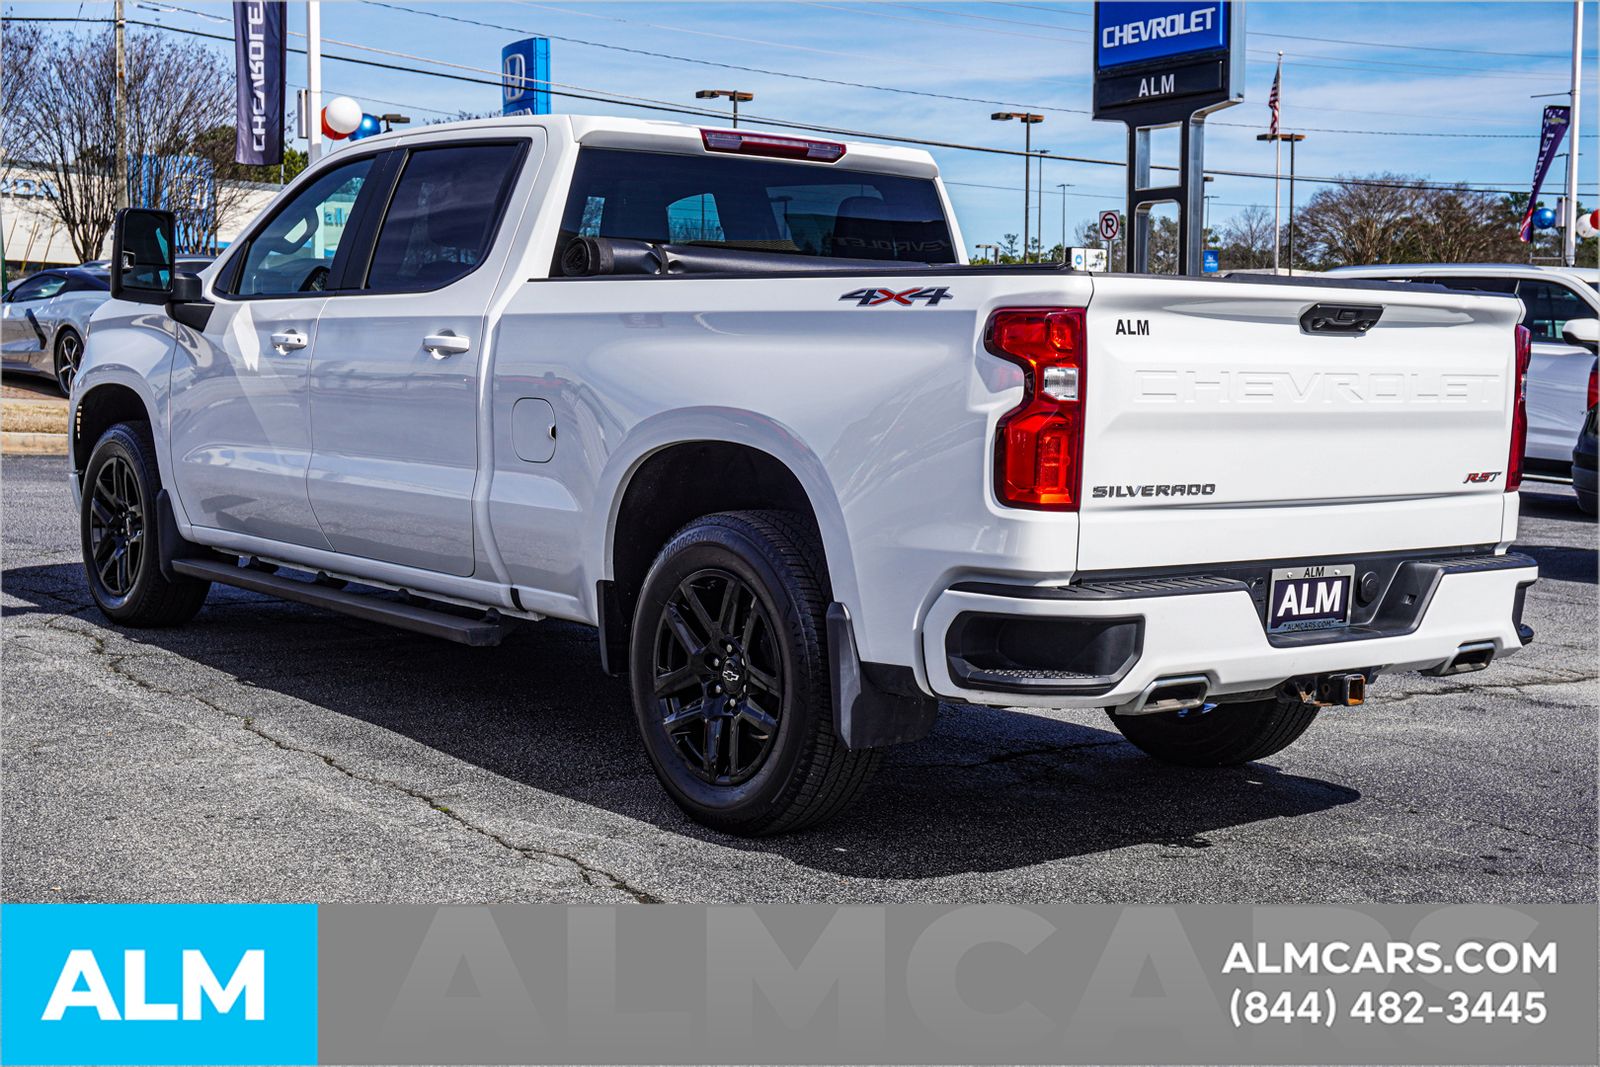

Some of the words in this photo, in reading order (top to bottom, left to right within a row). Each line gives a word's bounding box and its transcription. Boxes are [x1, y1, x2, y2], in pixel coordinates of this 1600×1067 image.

[1102, 7, 1216, 48] CHEVROLET
[1138, 74, 1175, 97] ALM
[1115, 319, 1150, 335] ALM
[1133, 369, 1500, 404] CHEVROLET
[1462, 471, 1502, 484] RST
[1092, 483, 1216, 498] SILVERADO
[1303, 566, 1325, 578] ALM
[1276, 580, 1342, 617] ALM
